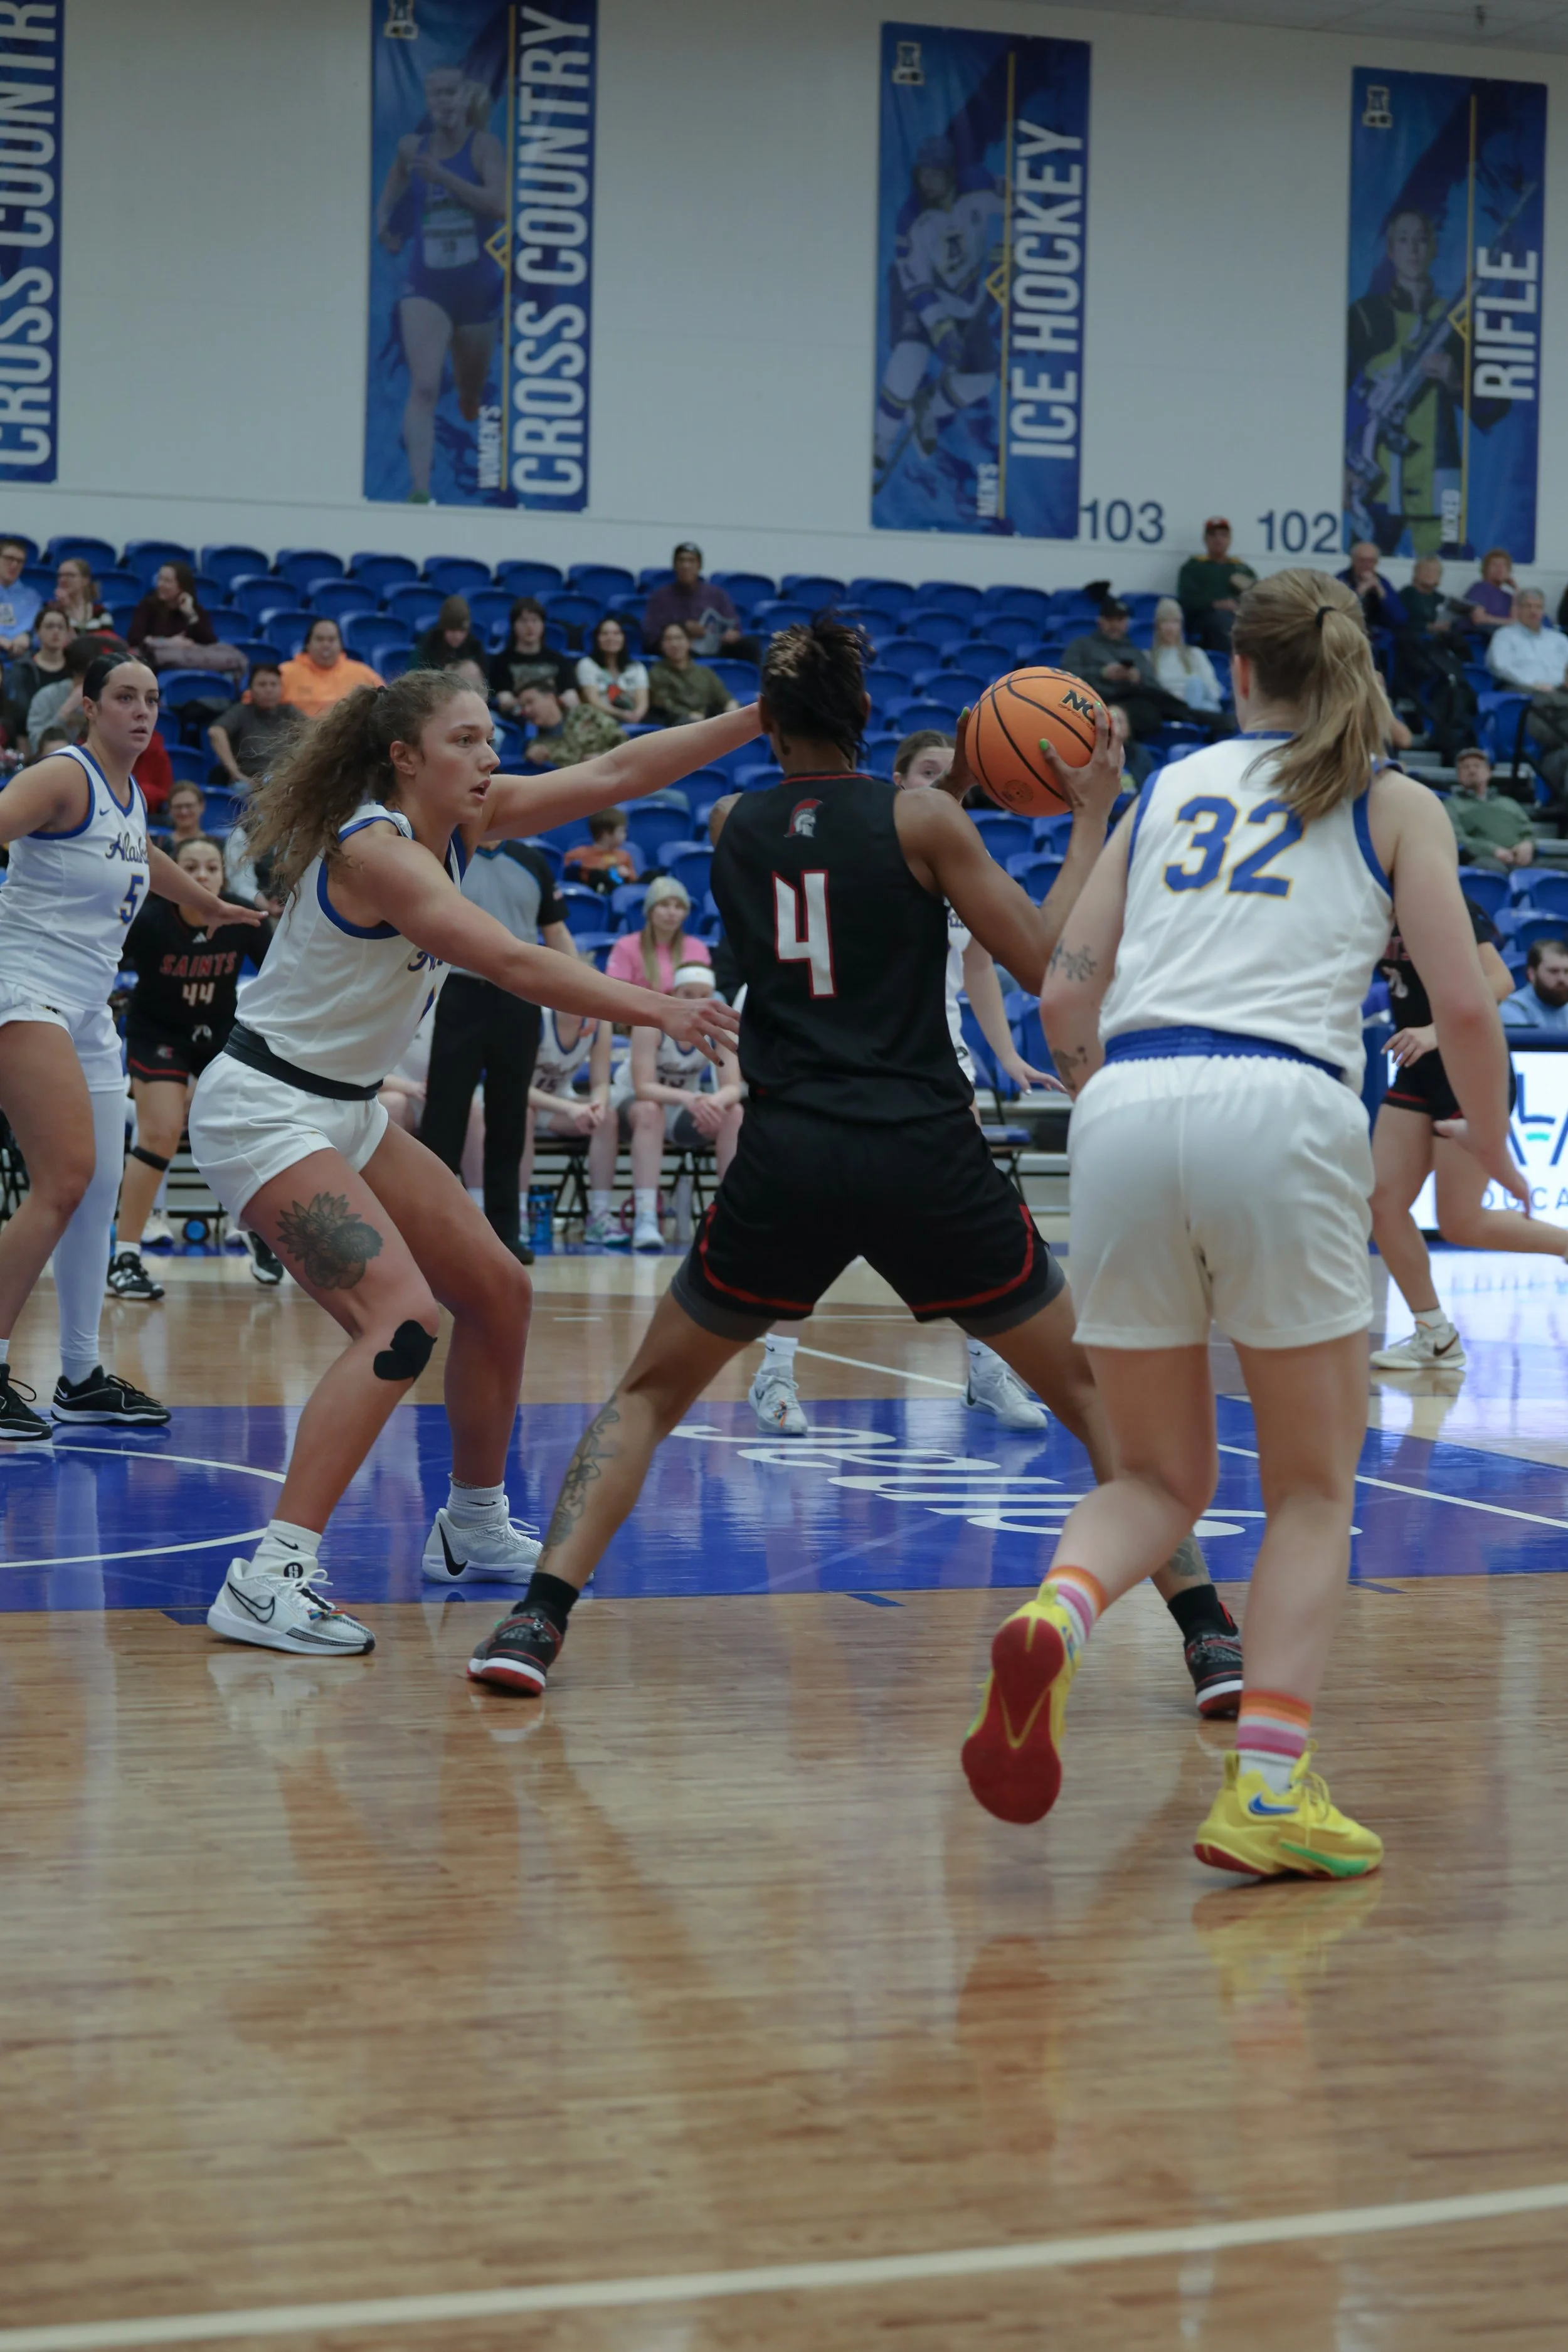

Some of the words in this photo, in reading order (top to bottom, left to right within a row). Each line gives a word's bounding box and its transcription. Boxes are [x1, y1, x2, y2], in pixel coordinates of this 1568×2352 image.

[516, 6, 590, 287] COUNTRY
[1014, 119, 1083, 354] HOCKEY
[0, 266, 54, 466] CROSS
[1474, 246, 1537, 400] RIFLE
[511, 301, 586, 496] CROSS
[1009, 369, 1078, 459] ICE
[1080, 497, 1165, 544] 103
[1257, 509, 1338, 553] 102
[120, 872, 144, 925] 5
[1162, 795, 1308, 899] 32
[159, 951, 237, 978] SAINTS
[771, 869, 837, 999] 4
[183, 982, 215, 1007] 44
